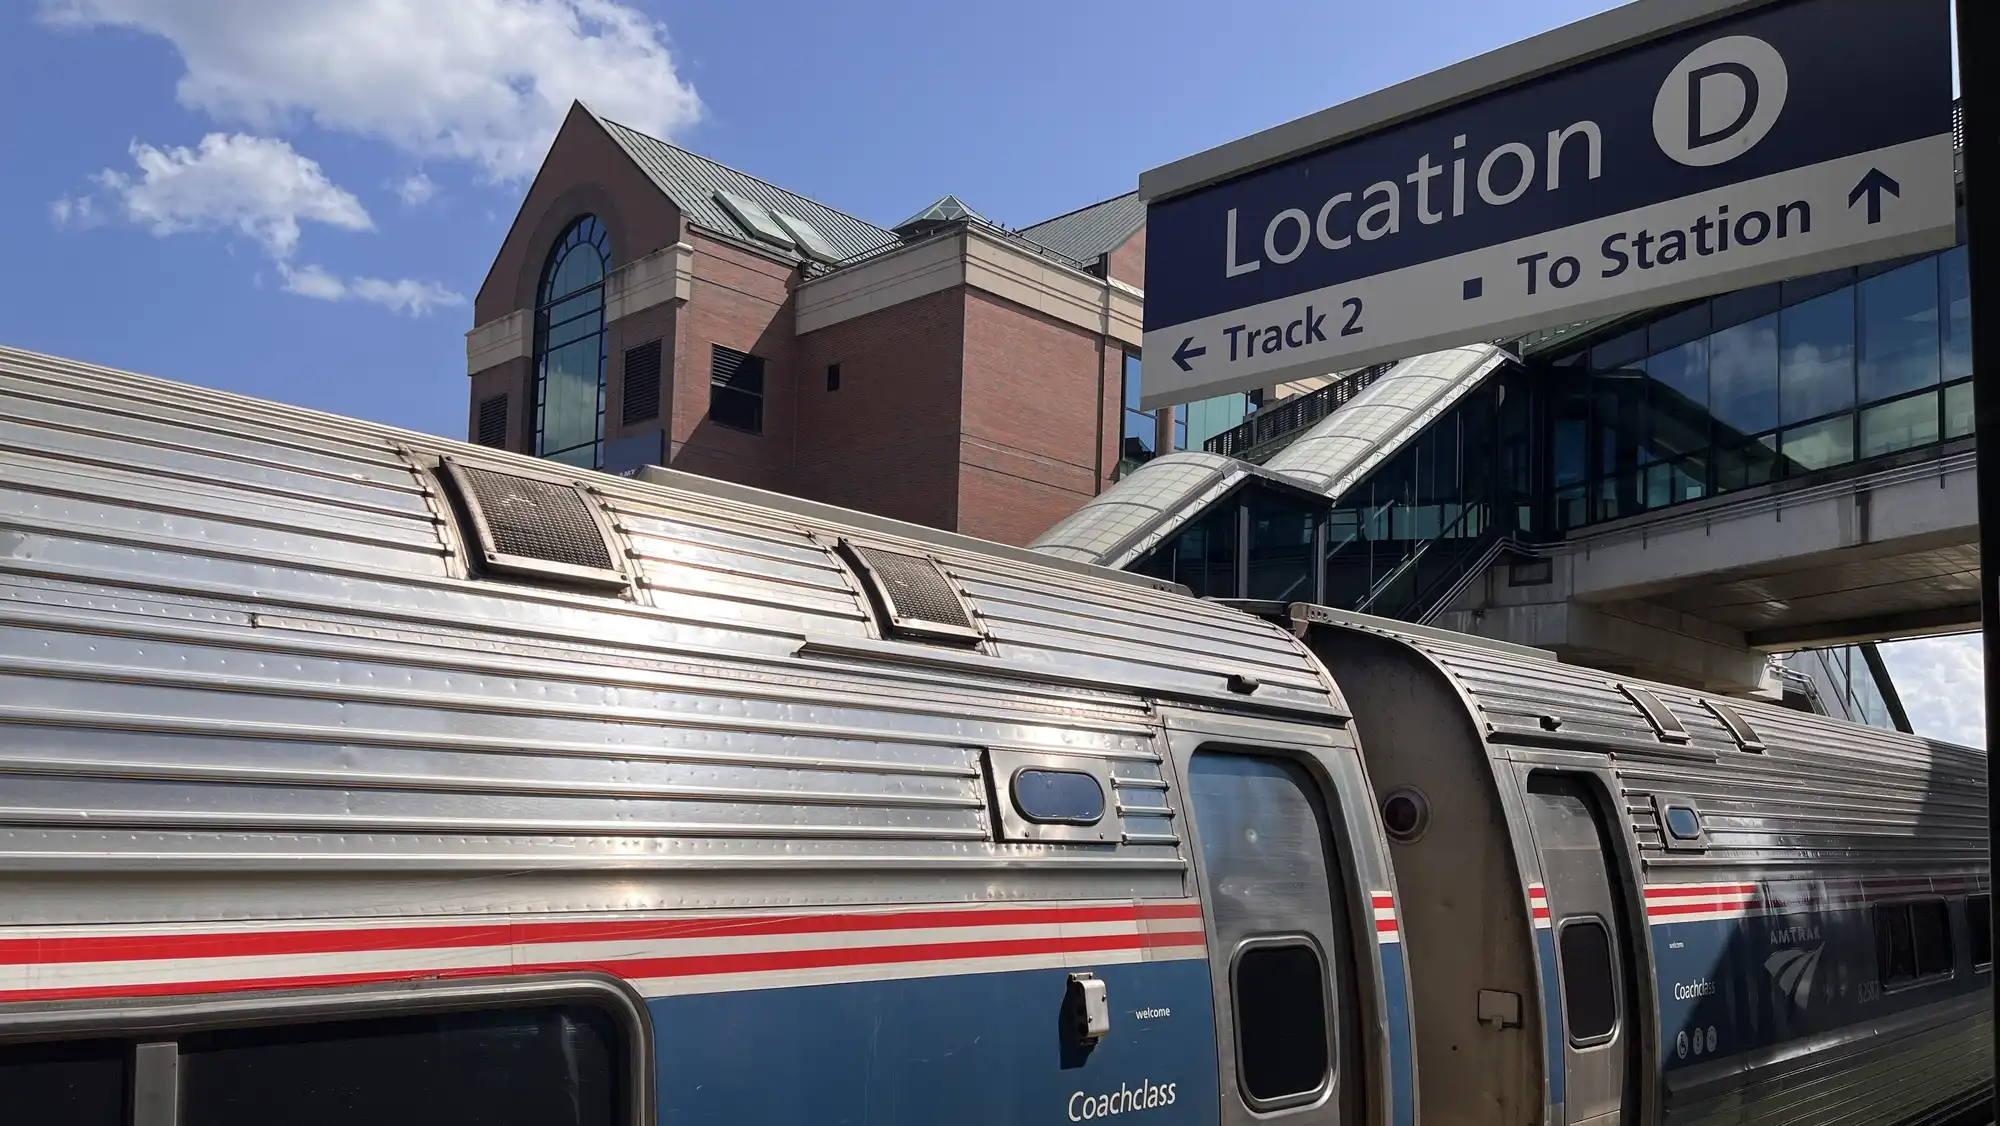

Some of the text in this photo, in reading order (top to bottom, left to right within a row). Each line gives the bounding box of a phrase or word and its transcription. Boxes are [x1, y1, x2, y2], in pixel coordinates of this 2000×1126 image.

[1225, 62, 1759, 279] Location D
[1517, 199, 1811, 295] To Station
[1223, 297, 1364, 364] Track 2
[1770, 926, 1820, 944] AMTRAK
[1674, 977, 1715, 1001] Coachclass
[1135, 1006, 1171, 1020] welcome
[1068, 1078, 1176, 1122] Coachclass
